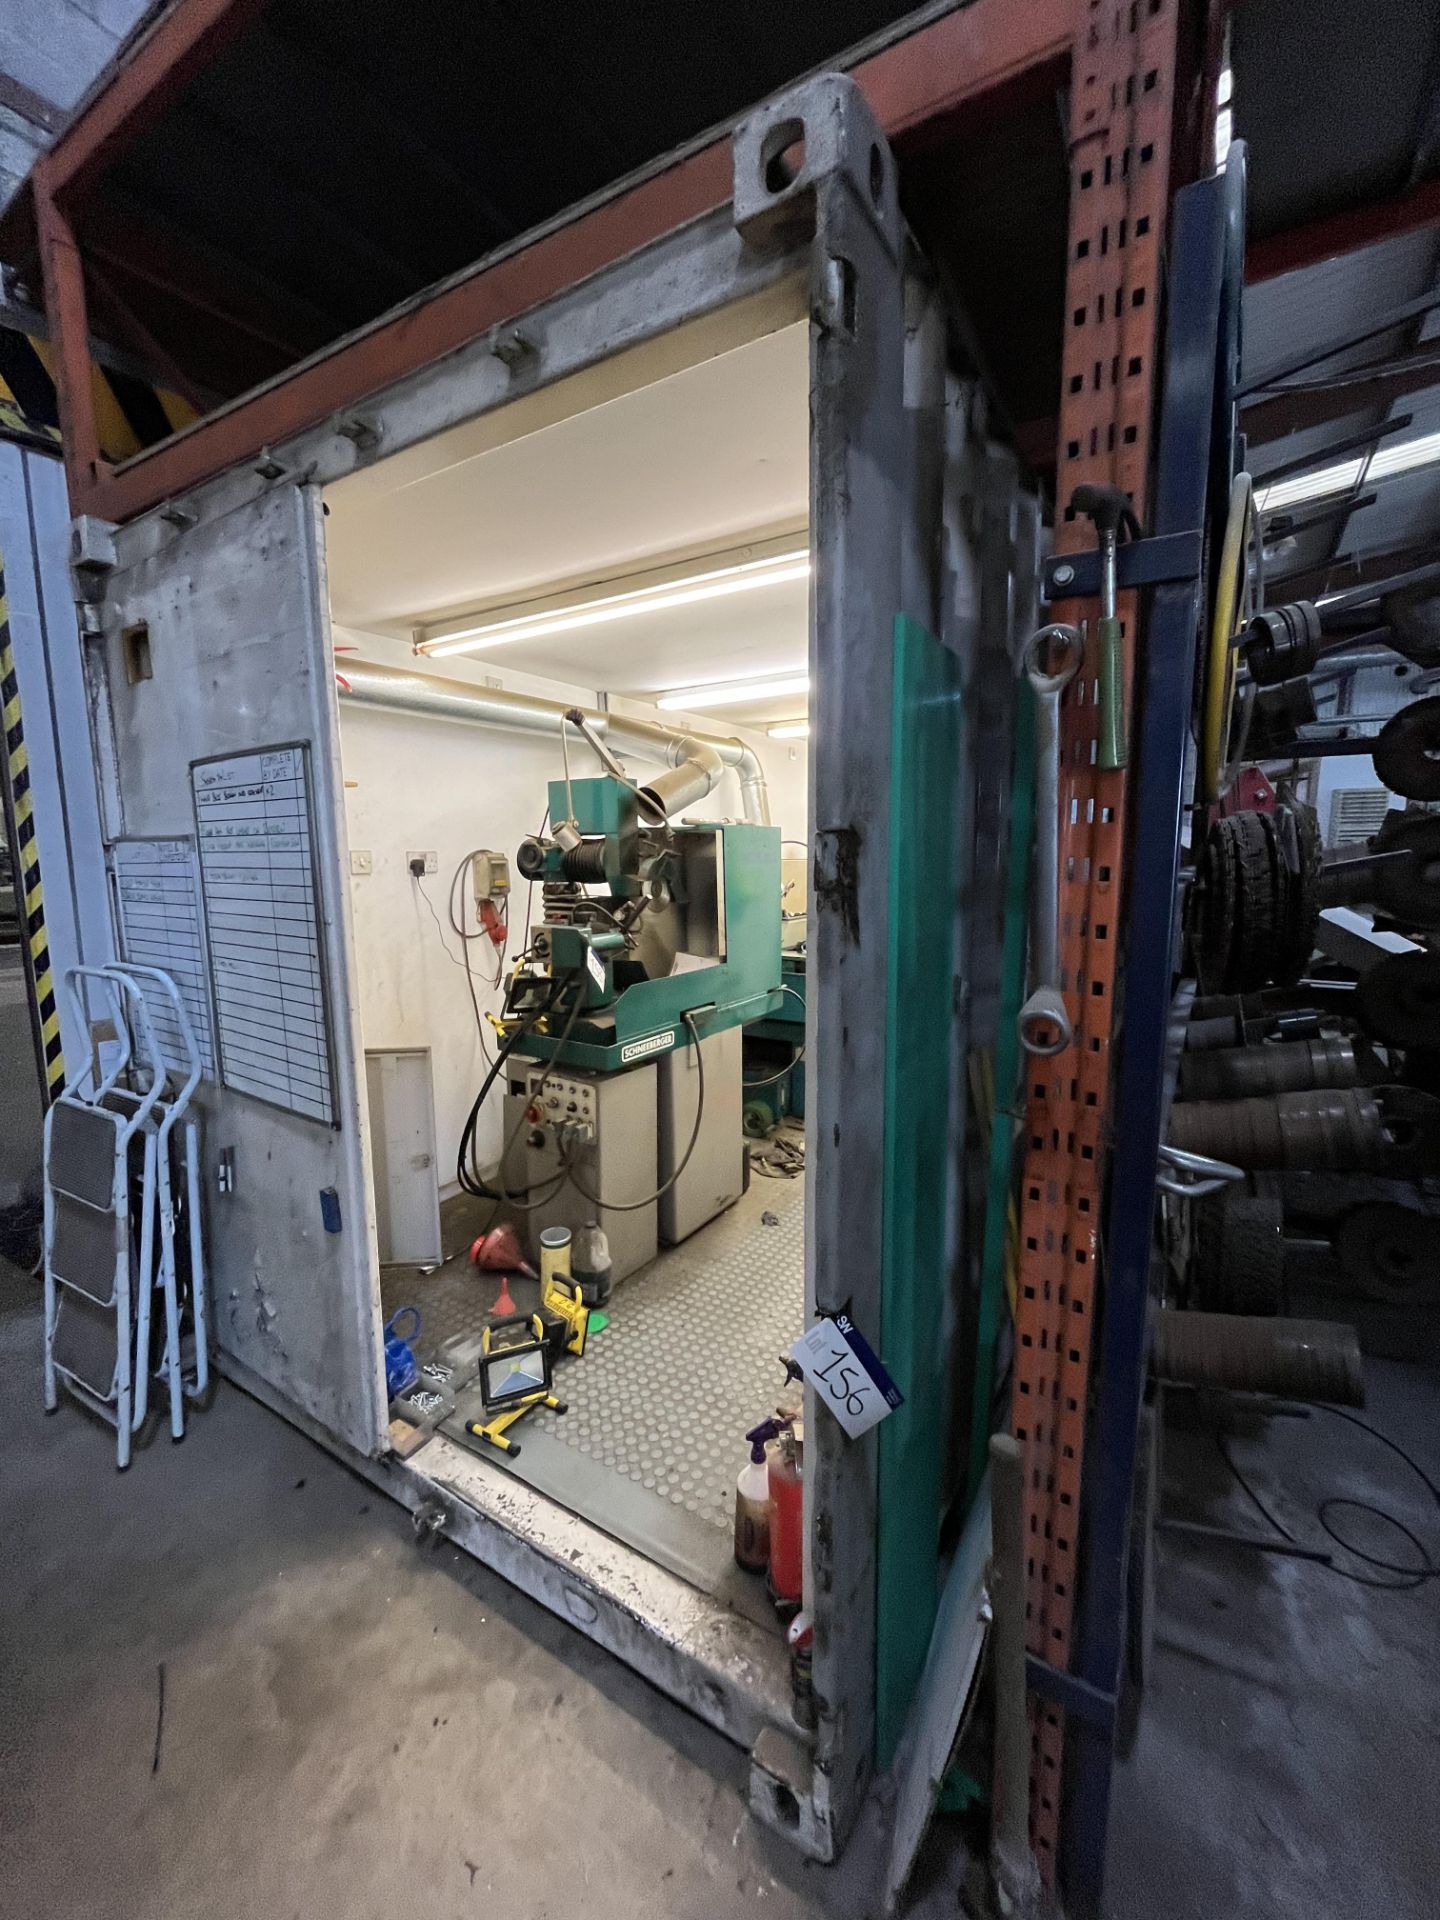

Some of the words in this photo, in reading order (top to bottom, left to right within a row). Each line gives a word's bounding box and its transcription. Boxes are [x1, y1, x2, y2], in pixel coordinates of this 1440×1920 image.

[272, 766, 288, 779] DATE
[624, 1034, 672, 1059] SCHNEEBERGER
[812, 1349, 871, 1416] 156
